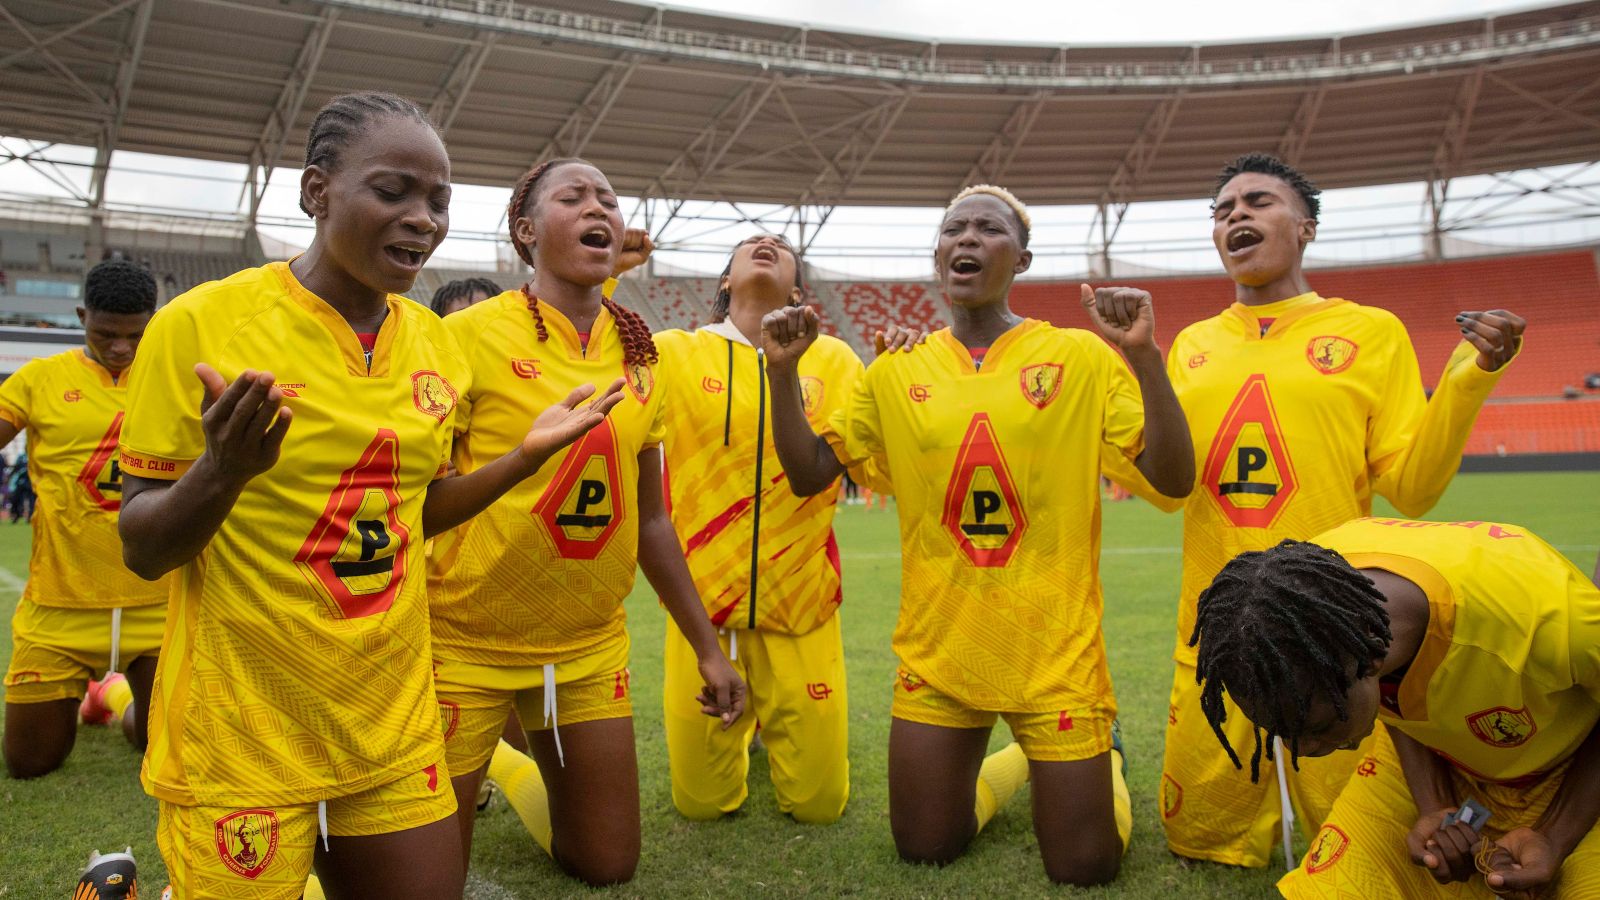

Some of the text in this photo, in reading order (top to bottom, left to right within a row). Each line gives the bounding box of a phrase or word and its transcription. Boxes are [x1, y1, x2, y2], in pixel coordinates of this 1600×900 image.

[148, 460, 176, 472] CLUB
[1238, 447, 1267, 481] P
[575, 480, 606, 514] P
[972, 490, 1001, 523] P
[356, 520, 390, 562] P
[223, 853, 247, 875] QUEENS
[260, 835, 277, 869] FOOTBALL
